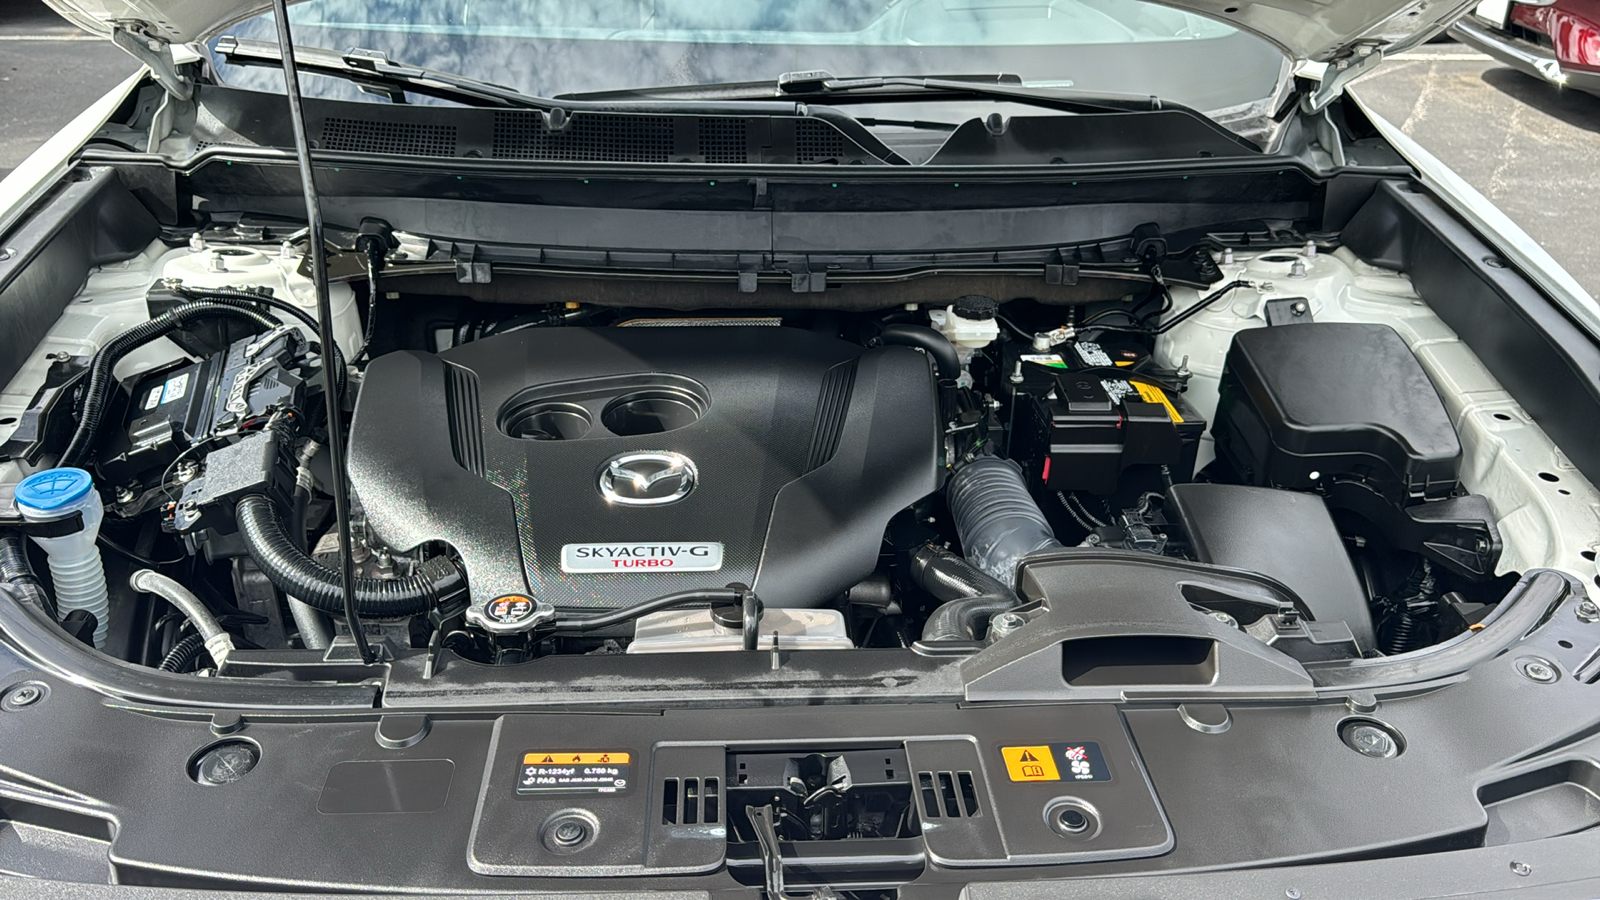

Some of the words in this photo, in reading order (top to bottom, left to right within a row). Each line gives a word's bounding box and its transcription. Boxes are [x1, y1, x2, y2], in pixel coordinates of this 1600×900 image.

[576, 546, 709, 558] SKYACTIV-G
[611, 559, 674, 567] TURBO
[538, 767, 575, 776] R-1234yf
[607, 767, 619, 775] kg
